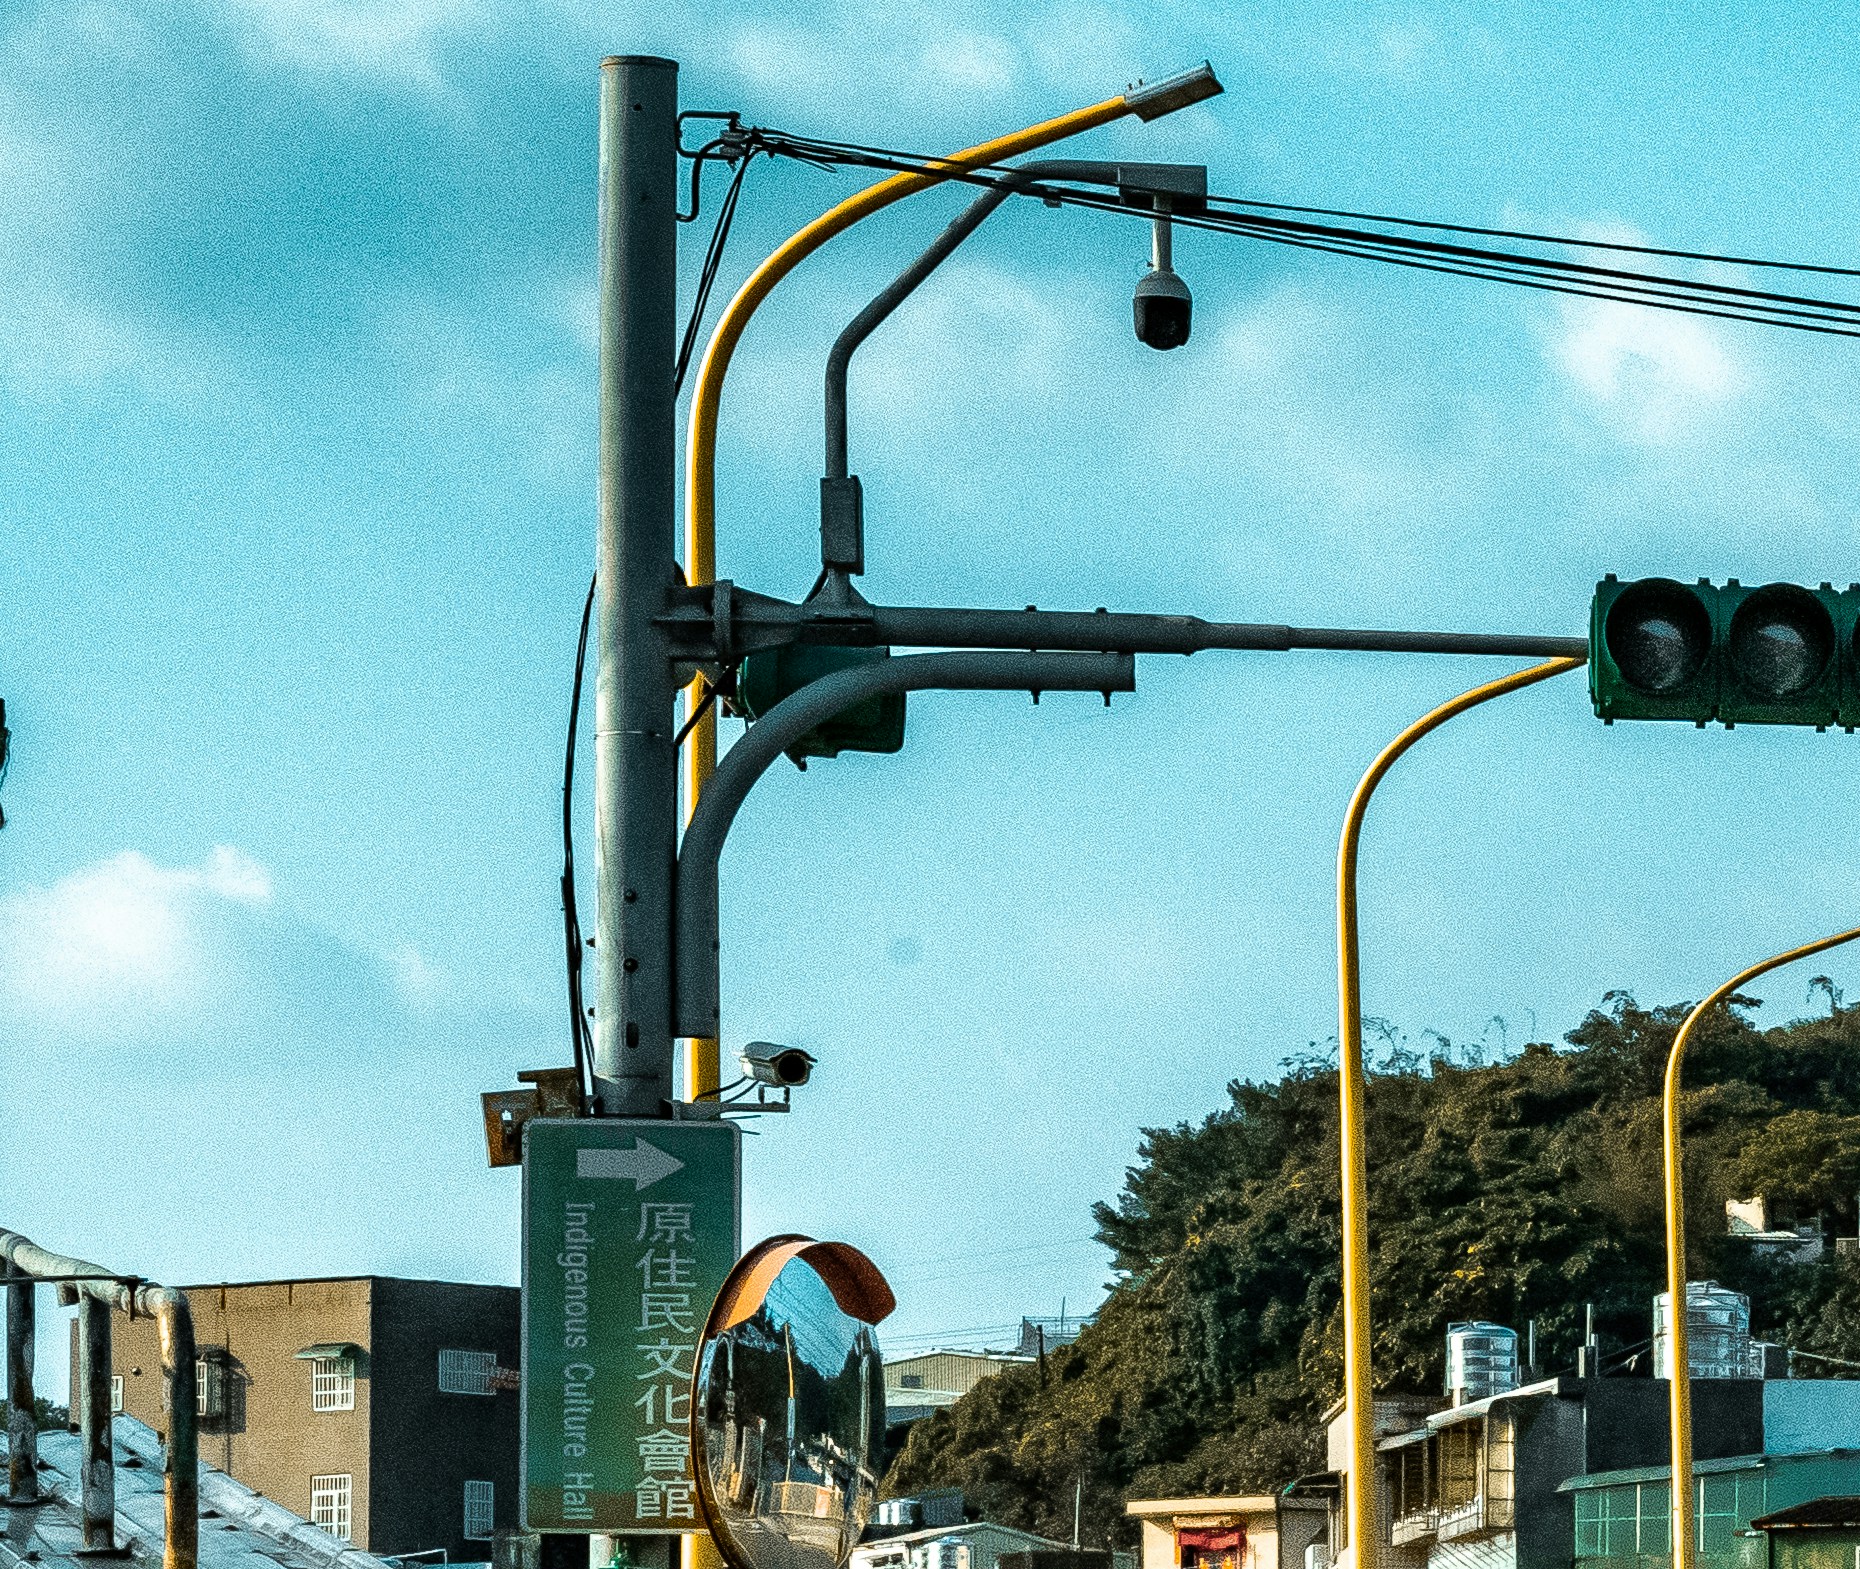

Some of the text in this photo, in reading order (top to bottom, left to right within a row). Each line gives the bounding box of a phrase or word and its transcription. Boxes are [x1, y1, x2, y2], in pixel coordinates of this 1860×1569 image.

[556, 1200, 596, 1521] Indigenous Culture Hall
[634, 1202, 697, 1519] 原住民文化會館
